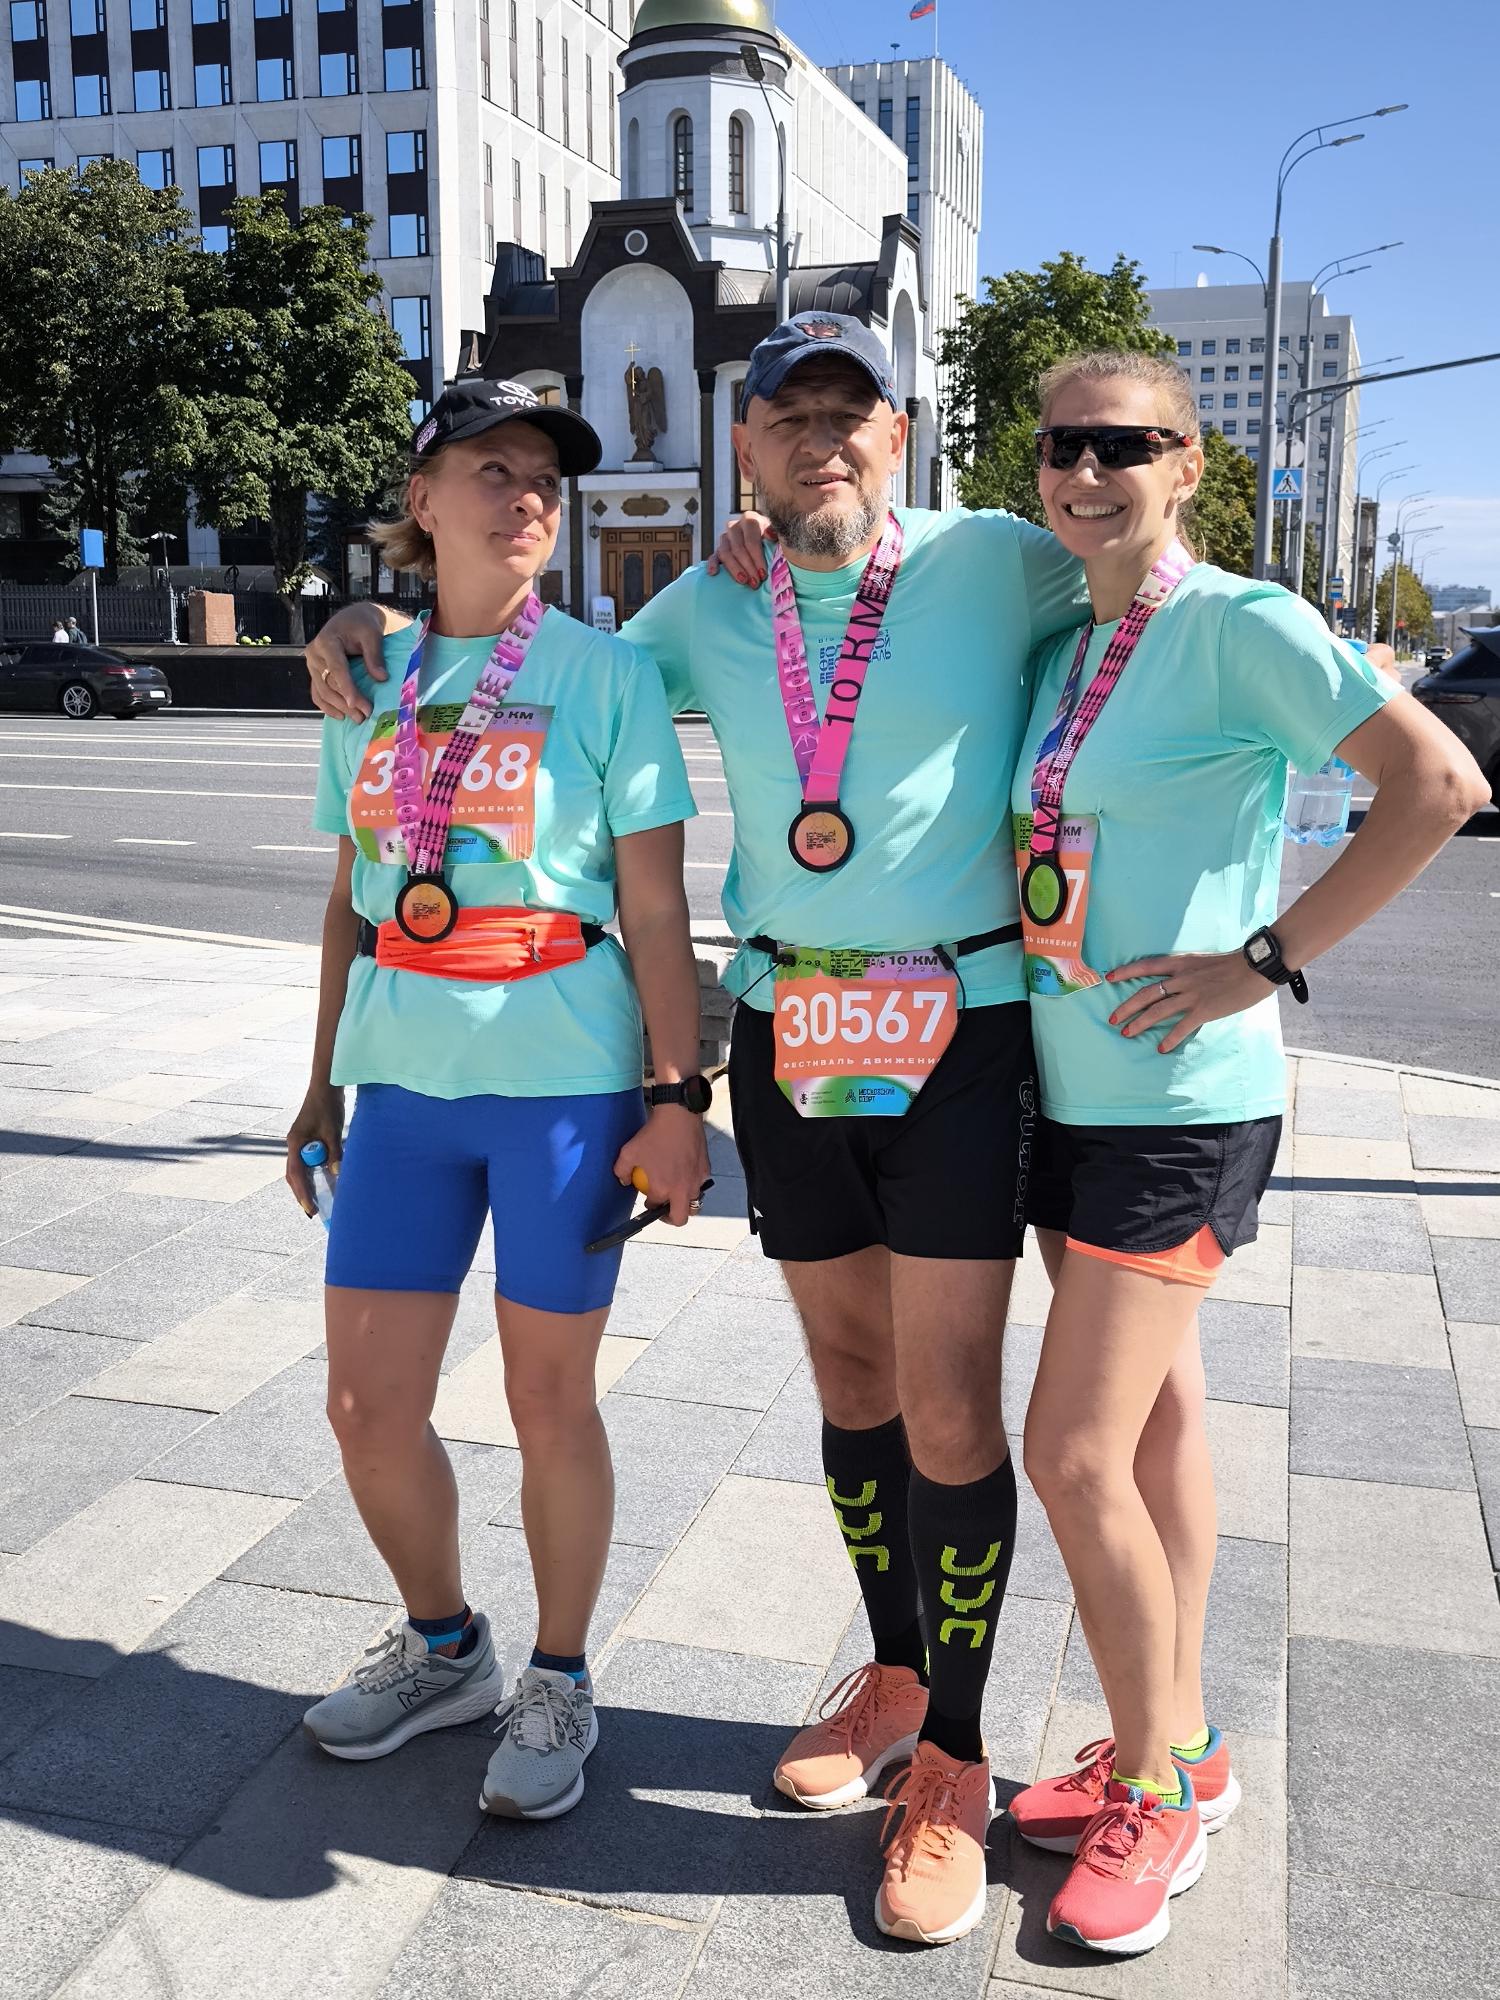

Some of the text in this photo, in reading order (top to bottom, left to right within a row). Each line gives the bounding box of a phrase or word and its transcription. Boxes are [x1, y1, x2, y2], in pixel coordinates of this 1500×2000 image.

[489, 396, 538, 408] TOYO
[888, 955, 908, 966] 10
[780, 990, 948, 1048] 30567
[783, 1056, 942, 1069] ФЕСТИВАЛЬ ДВИЖЕНИ
